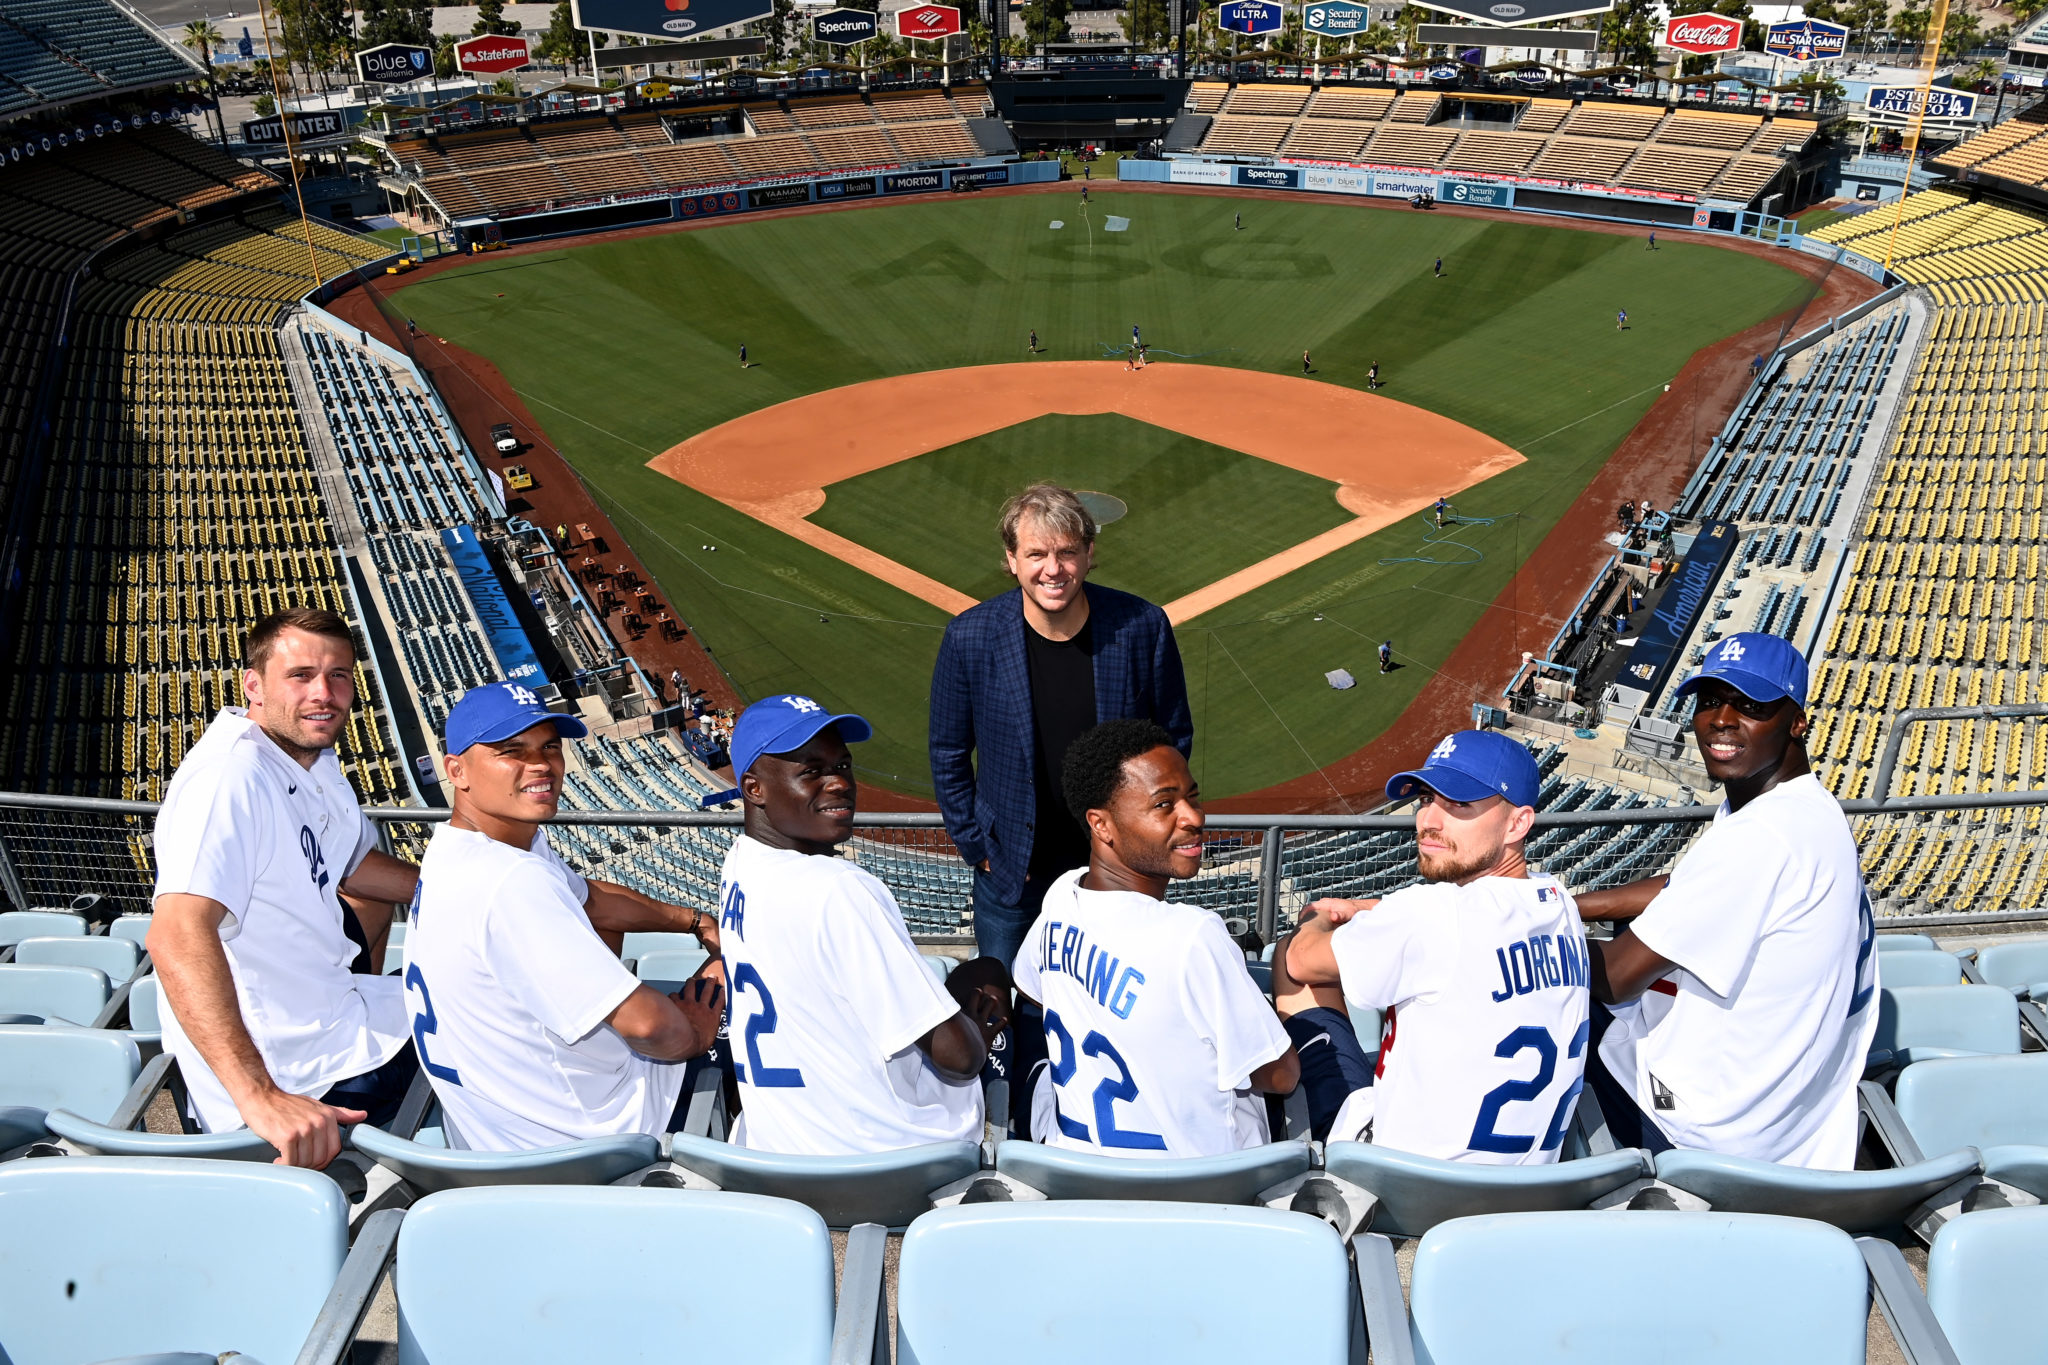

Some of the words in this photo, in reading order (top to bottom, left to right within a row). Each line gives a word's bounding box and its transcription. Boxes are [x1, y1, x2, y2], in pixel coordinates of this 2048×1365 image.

[1233, 10, 1268, 19] ULTRA
[1328, 9, 1363, 20] Security
[819, 21, 868, 34] Spectrum
[1328, 19, 1358, 29] Benefit
[1671, 22, 1735, 46] Coca-Cola
[1769, 33, 1786, 44] ALL
[1812, 35, 1843, 48] GAME
[366, 55, 407, 72] blue
[375, 69, 414, 79] california
[1518, 71, 1544, 79] DASANI
[1875, 100, 1944, 115] JALISCO
[250, 116, 337, 140] CUTWATER
[985, 171, 1006, 180] SELTZER
[1248, 169, 1286, 180] Spectrum
[1308, 174, 1325, 184] blue
[897, 176, 938, 187] MORTON
[1338, 177, 1355, 186] blue
[824, 186, 842, 194] UCLA
[846, 182, 871, 192] Health
[1376, 181, 1435, 195] smartwater
[1469, 187, 1497, 198] Security
[1469, 194, 1493, 203] Benefit
[1653, 560, 1717, 639] American
[1719, 637, 1746, 662] LA
[501, 683, 539, 706] LA
[781, 695, 821, 713] LA
[1432, 733, 1457, 759] LA
